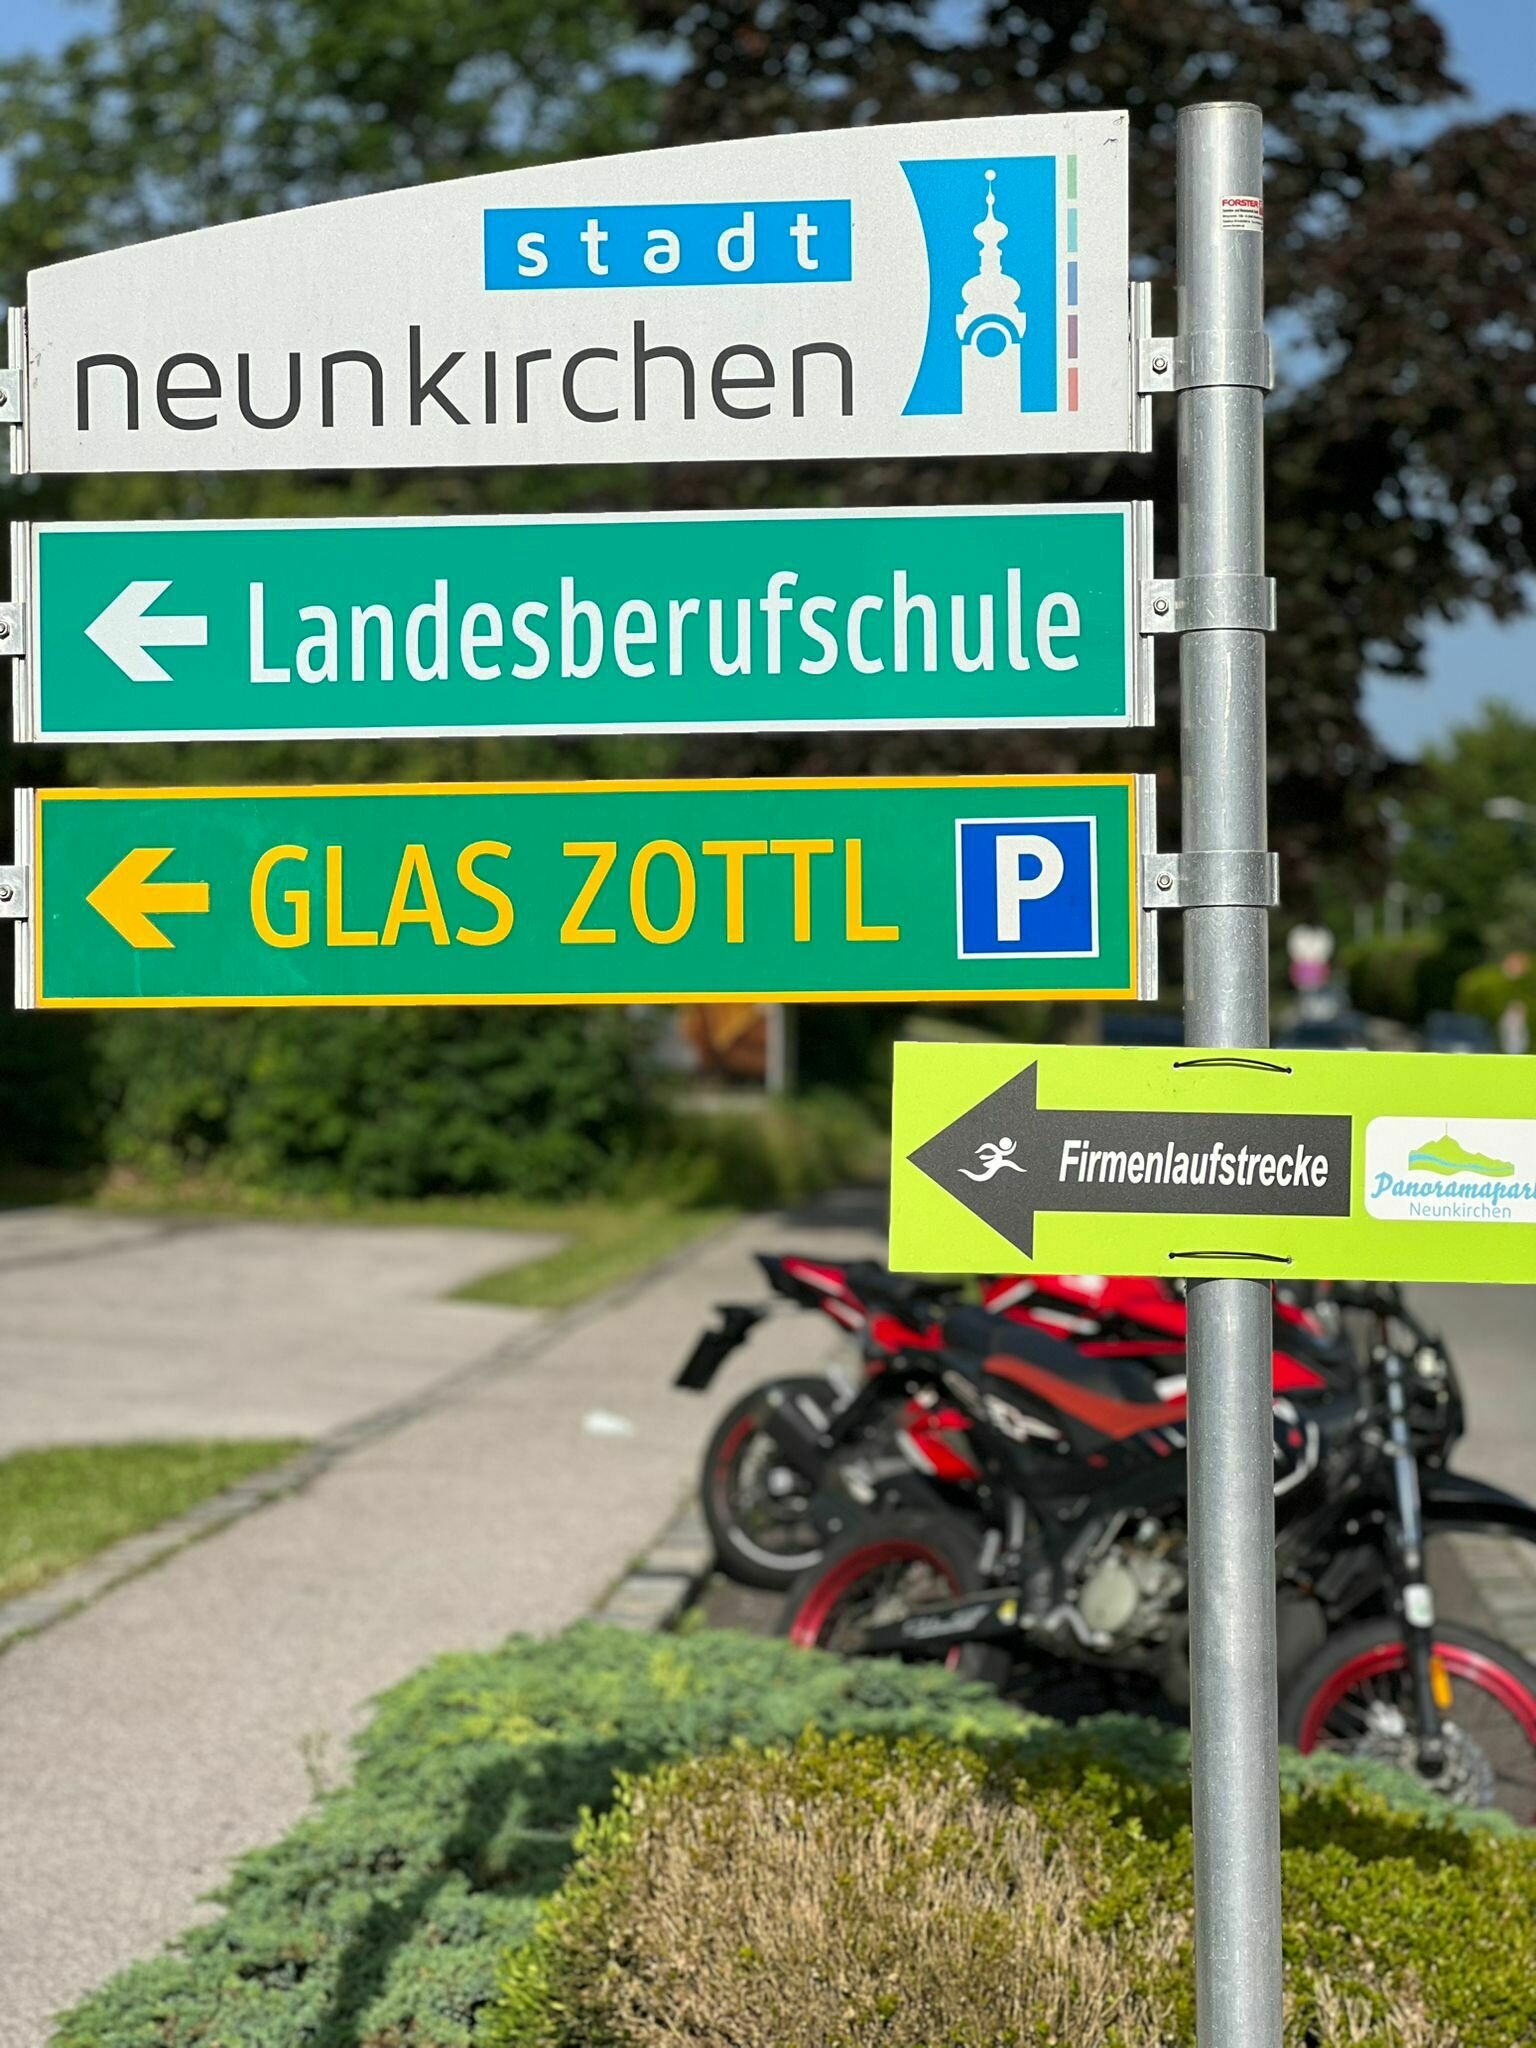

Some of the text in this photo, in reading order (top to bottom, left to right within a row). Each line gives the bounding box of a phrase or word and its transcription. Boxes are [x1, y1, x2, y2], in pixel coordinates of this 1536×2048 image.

[1222, 199, 1259, 208] FORSTER
[516, 208, 822, 279] stadt
[76, 320, 854, 431] neunkirchen
[249, 569, 1083, 684] Landesberufschule
[250, 834, 1066, 948] GLAS ZOTTL P
[1059, 1139, 1329, 1187] Firmenlaufstrecke
[1371, 1171, 1536, 1206] Panoramapar
[1409, 1202, 1512, 1219] Neunkirchen
